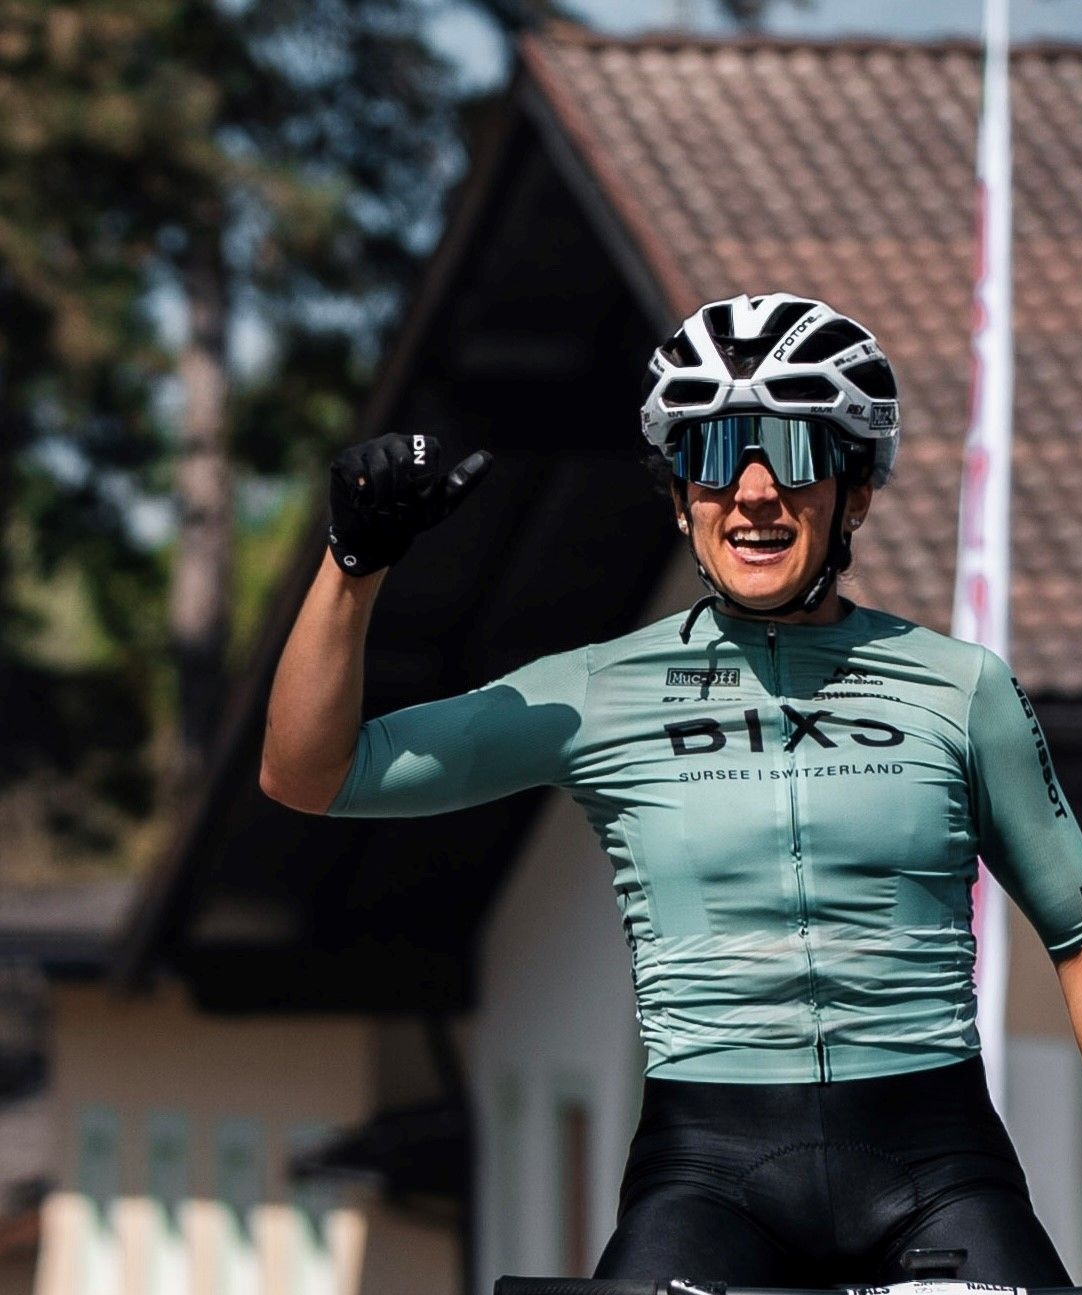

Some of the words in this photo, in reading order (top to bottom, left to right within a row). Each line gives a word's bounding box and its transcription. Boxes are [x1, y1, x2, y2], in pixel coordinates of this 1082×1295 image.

[412, 434, 426, 465] ION
[671, 671, 737, 686] Muc-Off
[679, 769, 750, 783] SURSEE
[769, 763, 904, 780] SWITZERLAND
[1030, 719, 1068, 819] TISSOT
